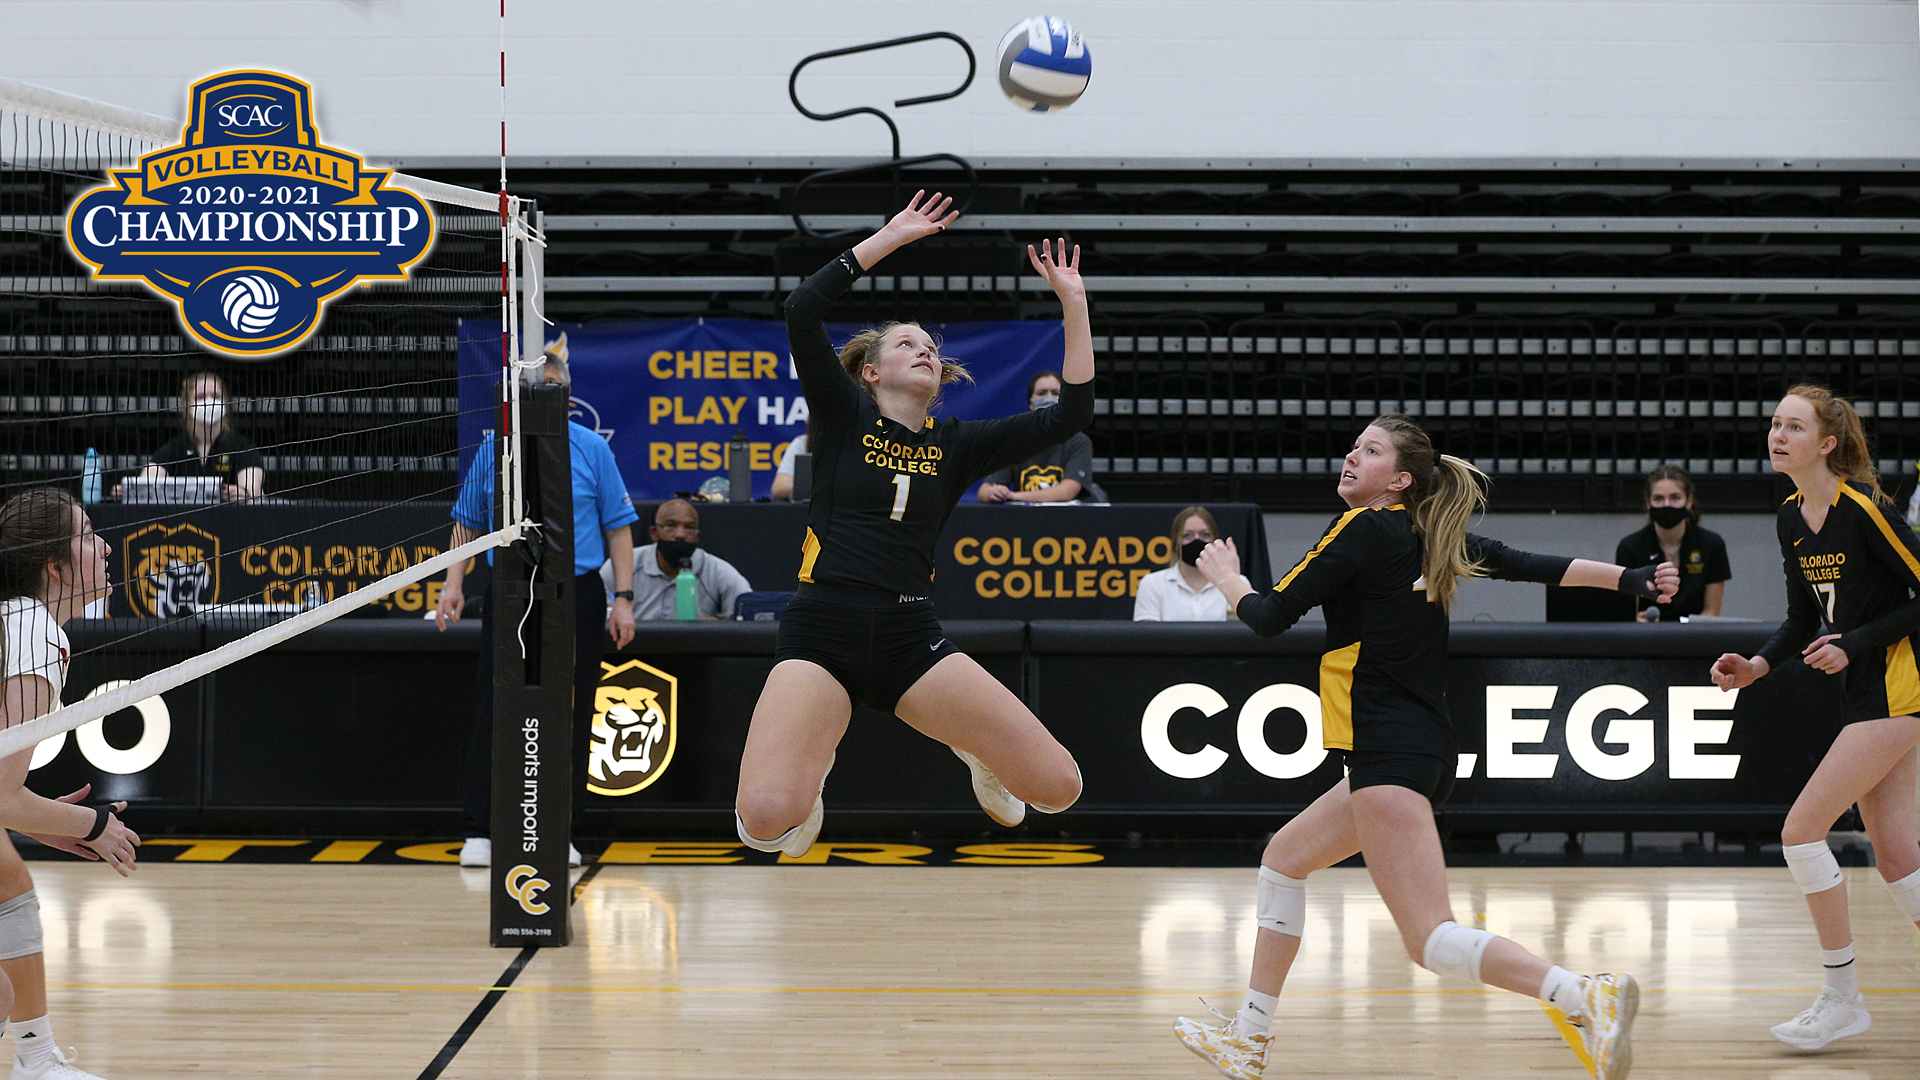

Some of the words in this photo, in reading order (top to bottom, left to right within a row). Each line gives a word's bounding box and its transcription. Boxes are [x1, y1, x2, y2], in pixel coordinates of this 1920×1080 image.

[648, 350, 778, 380] CHEER
[649, 396, 748, 425] PLAY
[758, 396, 810, 426] HA
[862, 433, 943, 461] COLORADO
[864, 450, 938, 476] COLLEGE
[890, 473, 911, 522] 1
[240, 545, 476, 577] COLORAD
[953, 536, 1173, 566] COLORADO
[1141, 682, 1742, 781] COEGE
[521, 717, 541, 777] sports
